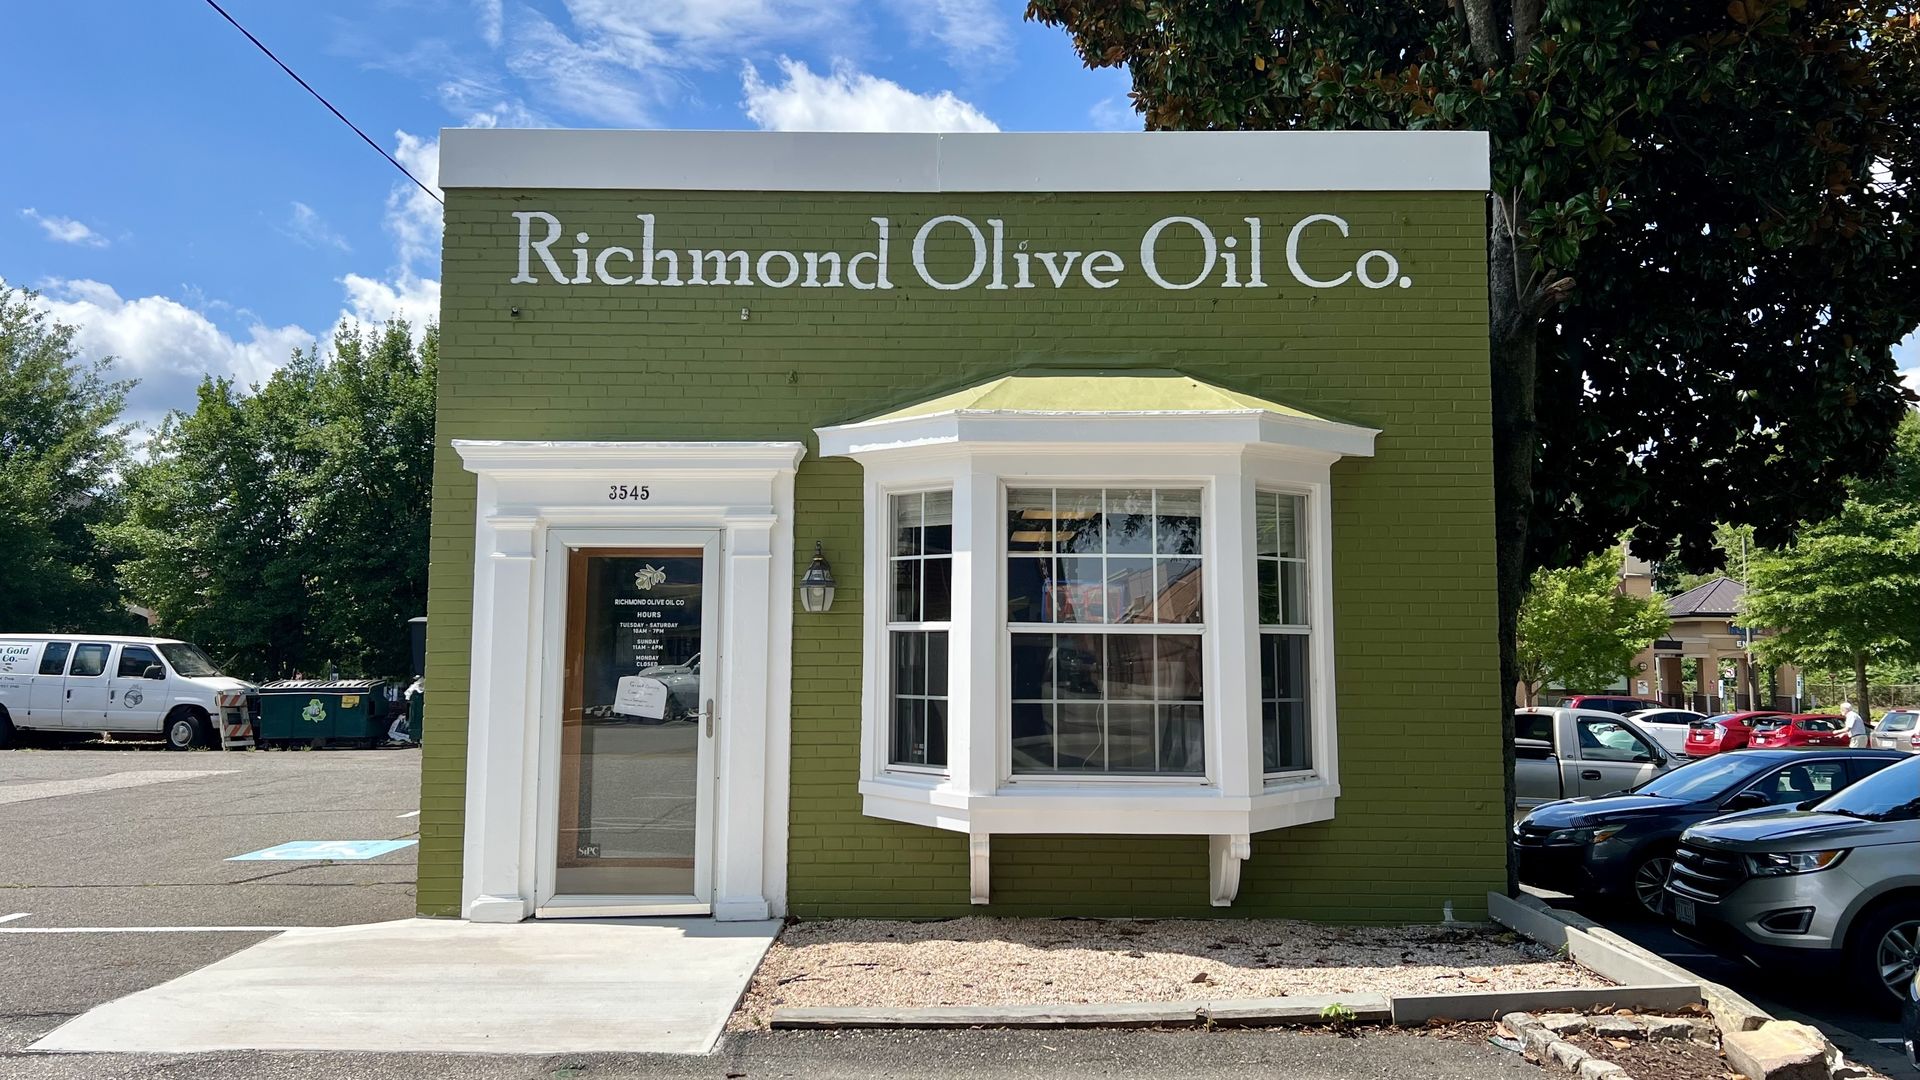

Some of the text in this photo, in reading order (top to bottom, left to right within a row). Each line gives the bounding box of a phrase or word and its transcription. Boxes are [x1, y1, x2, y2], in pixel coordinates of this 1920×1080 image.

[510, 211, 1412, 290] Richmond Olive Oil Co.
[608, 485, 650, 500] 3545
[6, 647, 30, 655] Gold
[2, 654, 18, 663] Co.
